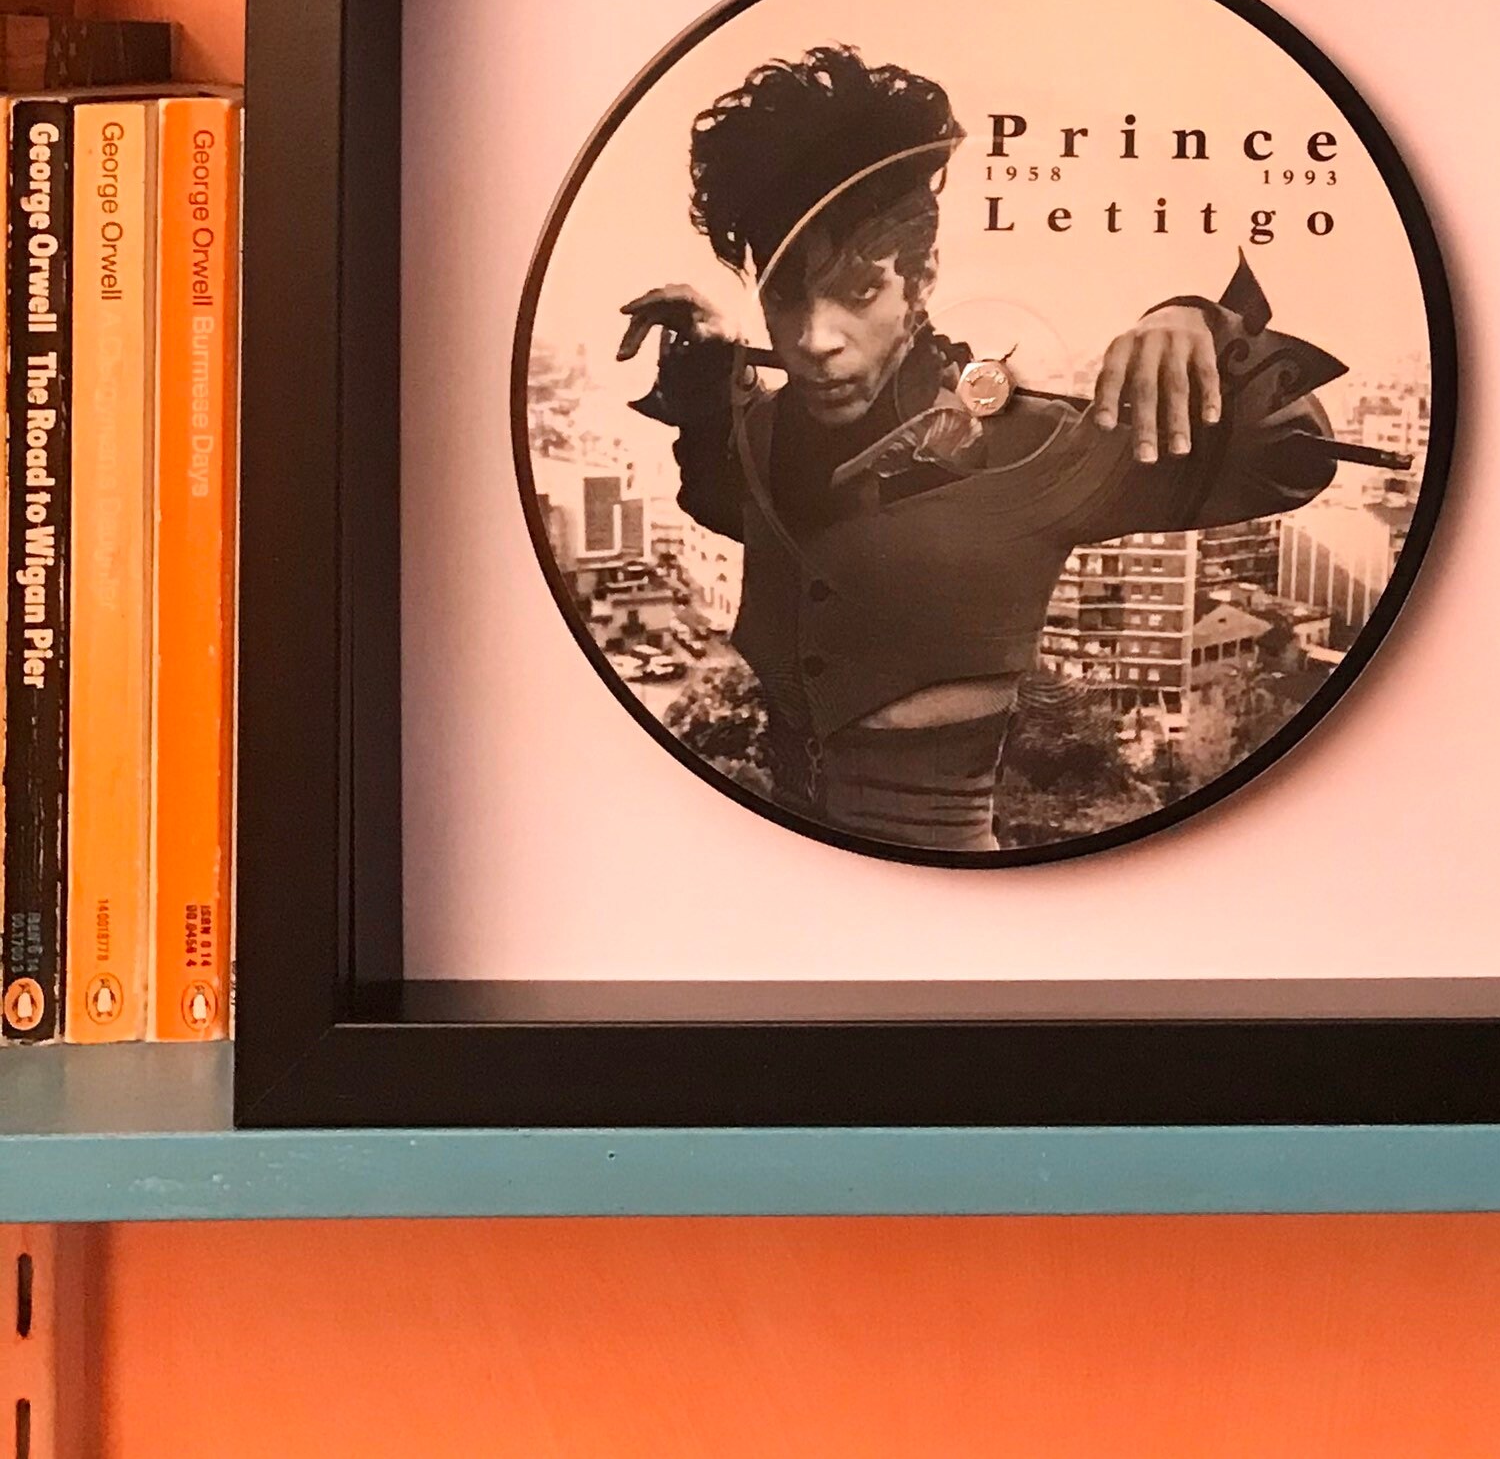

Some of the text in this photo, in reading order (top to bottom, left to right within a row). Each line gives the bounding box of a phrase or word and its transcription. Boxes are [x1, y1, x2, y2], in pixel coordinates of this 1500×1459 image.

[97, 121, 125, 214] George
[984, 165, 1338, 186] 1958 1993
[985, 113, 1338, 163] Prince
[100, 221, 124, 300] Orwell
[187, 129, 215, 498] George Orwell Burmese Days
[15, 122, 60, 690] George Orwell The Road to Wigan Pier
